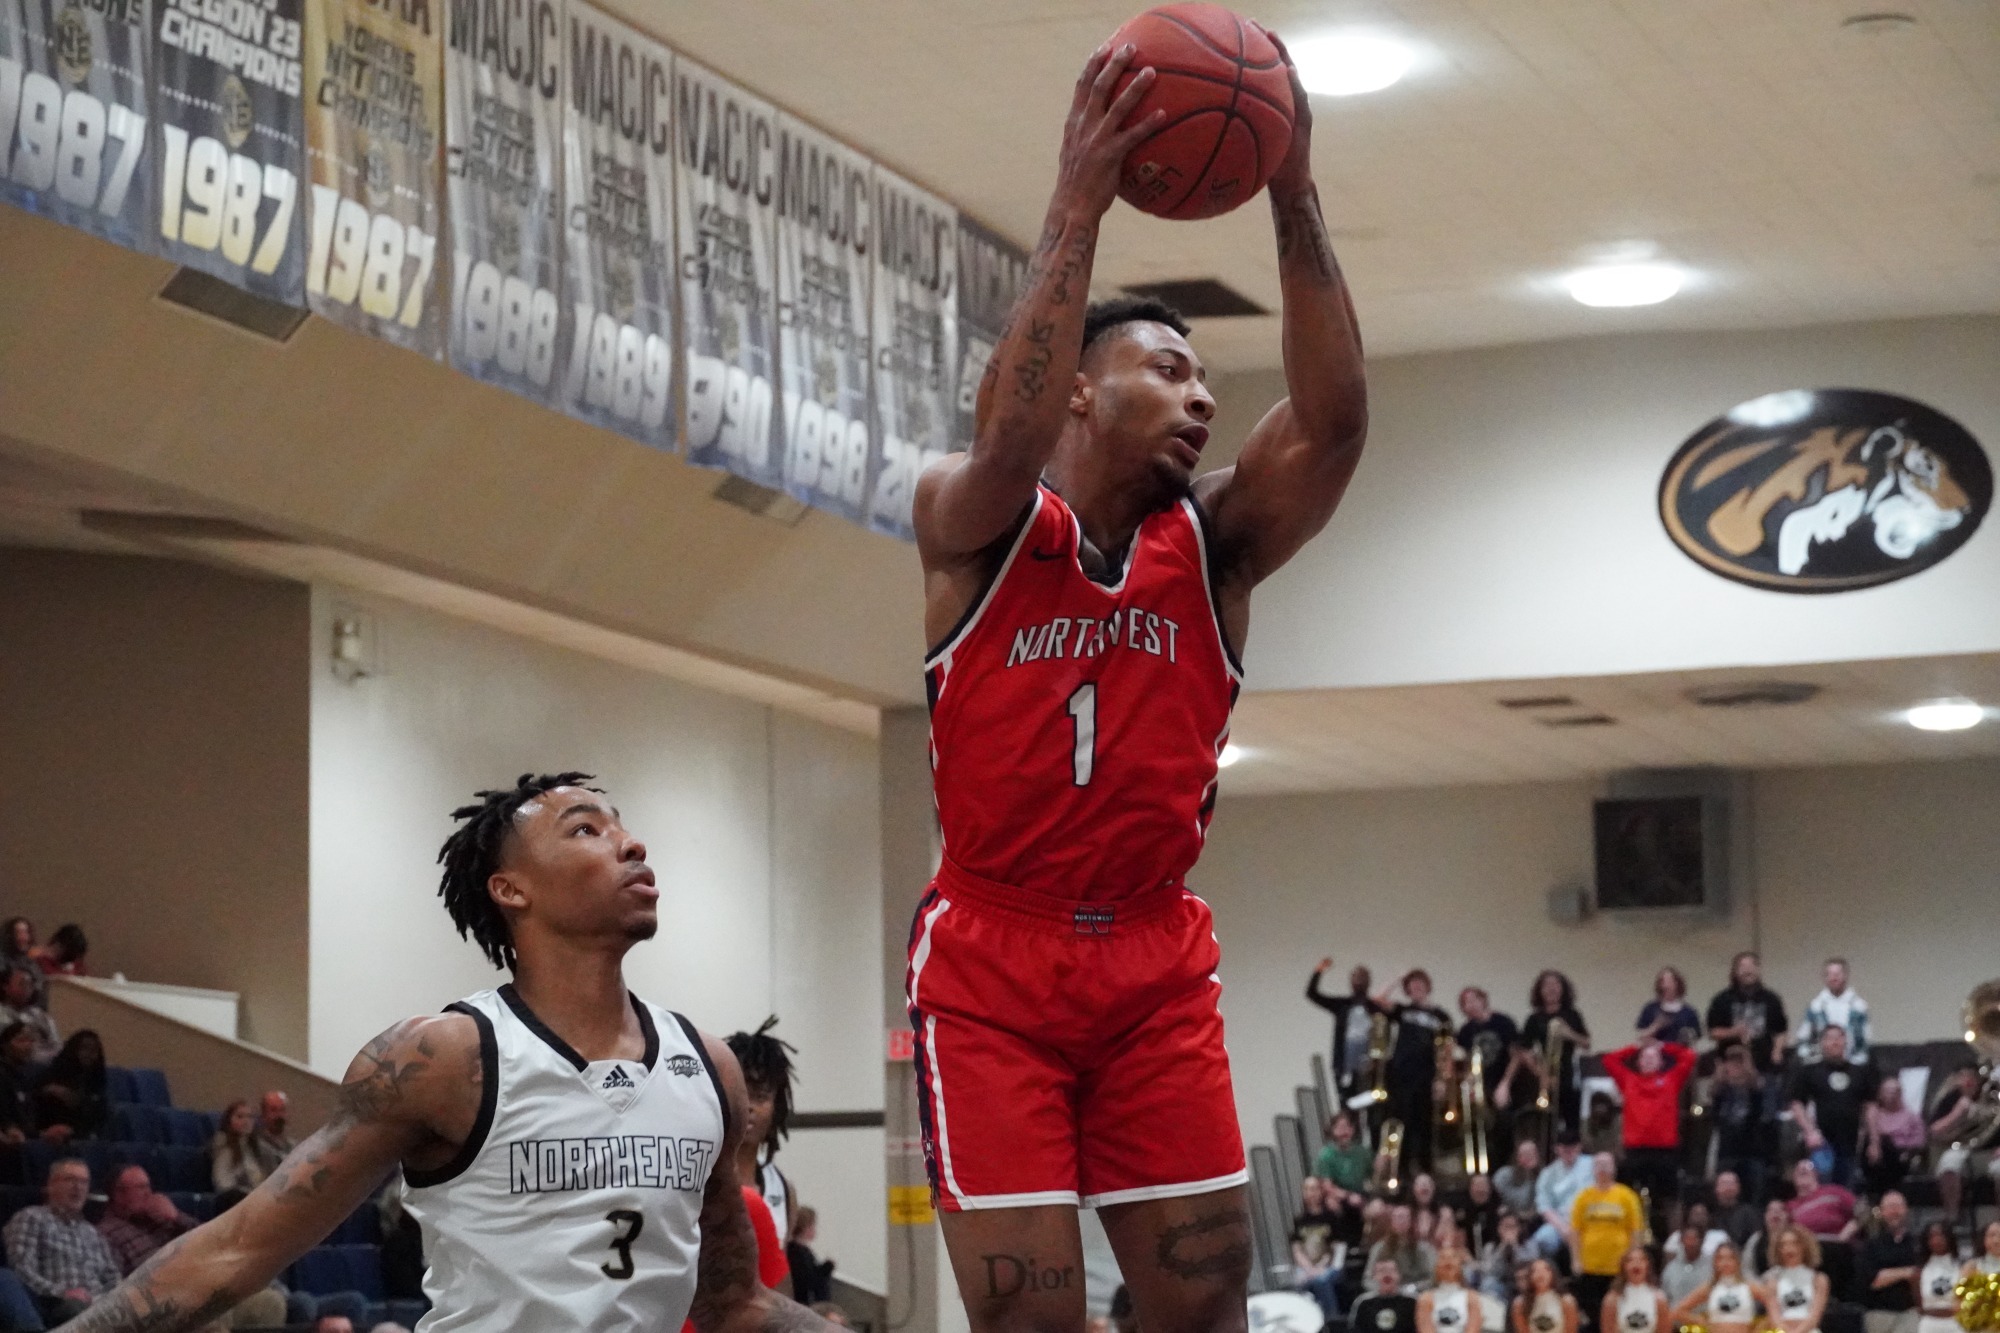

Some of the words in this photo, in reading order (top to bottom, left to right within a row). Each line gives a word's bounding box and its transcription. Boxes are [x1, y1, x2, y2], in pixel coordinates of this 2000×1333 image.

[160, 7, 302, 98] CHAMPIONS
[268, 15, 300, 58] 23
[161, 122, 298, 276] 1987
[306, 183, 436, 329] 1987
[450, 250, 559, 388] 1988
[562, 302, 672, 428] 1989
[1066, 680, 1098, 787] 1
[602, 1079, 635, 1090] adidas
[510, 1135, 714, 1194] NORTHEAST
[601, 1209, 643, 1280] 3
[980, 1254, 1074, 1299] Dior
